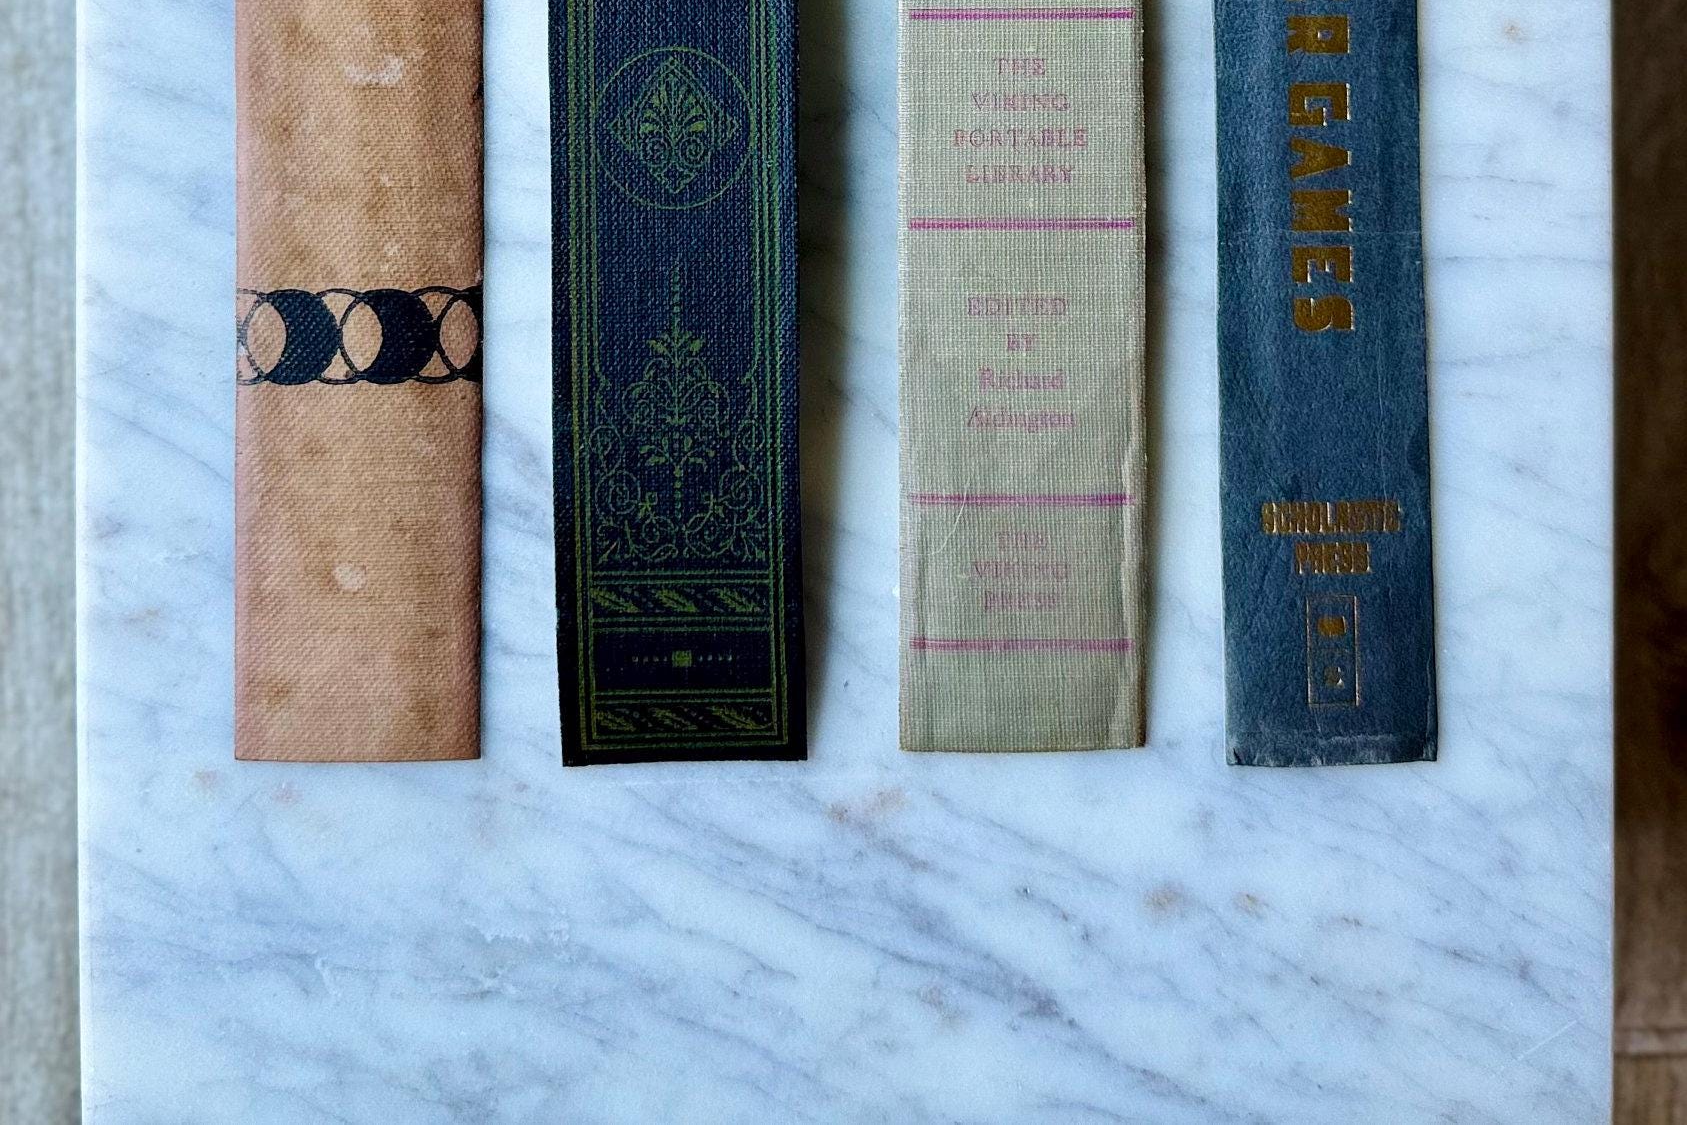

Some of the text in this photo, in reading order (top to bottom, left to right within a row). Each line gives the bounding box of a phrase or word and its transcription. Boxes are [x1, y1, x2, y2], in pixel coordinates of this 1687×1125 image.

[994, 57, 1046, 76] THE
[972, 92, 1072, 112] VIKING
[953, 128, 1088, 148] PORTABLE
[964, 164, 1074, 184] LIBRARY
[1287, 82, 1355, 332] GAMES
[967, 296, 1068, 316] EDITED
[1006, 333, 1039, 352] BY
[1295, 541, 1371, 574] PRESS
